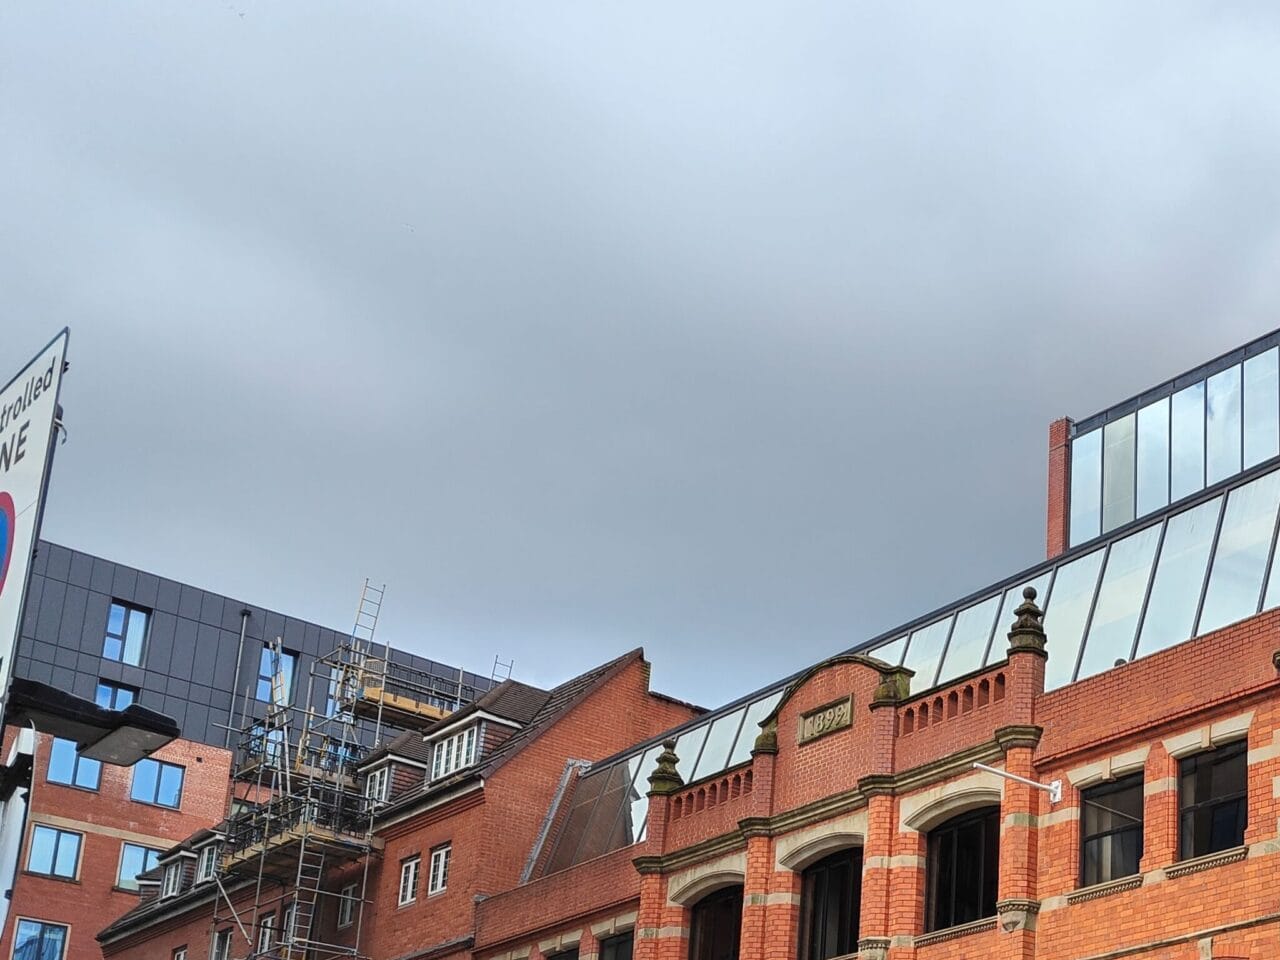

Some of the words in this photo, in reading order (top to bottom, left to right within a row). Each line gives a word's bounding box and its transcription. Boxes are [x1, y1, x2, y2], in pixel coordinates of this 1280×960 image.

[0, 356, 56, 433] trolled
[0, 420, 30, 473] NE
[804, 704, 848, 739] 1899
